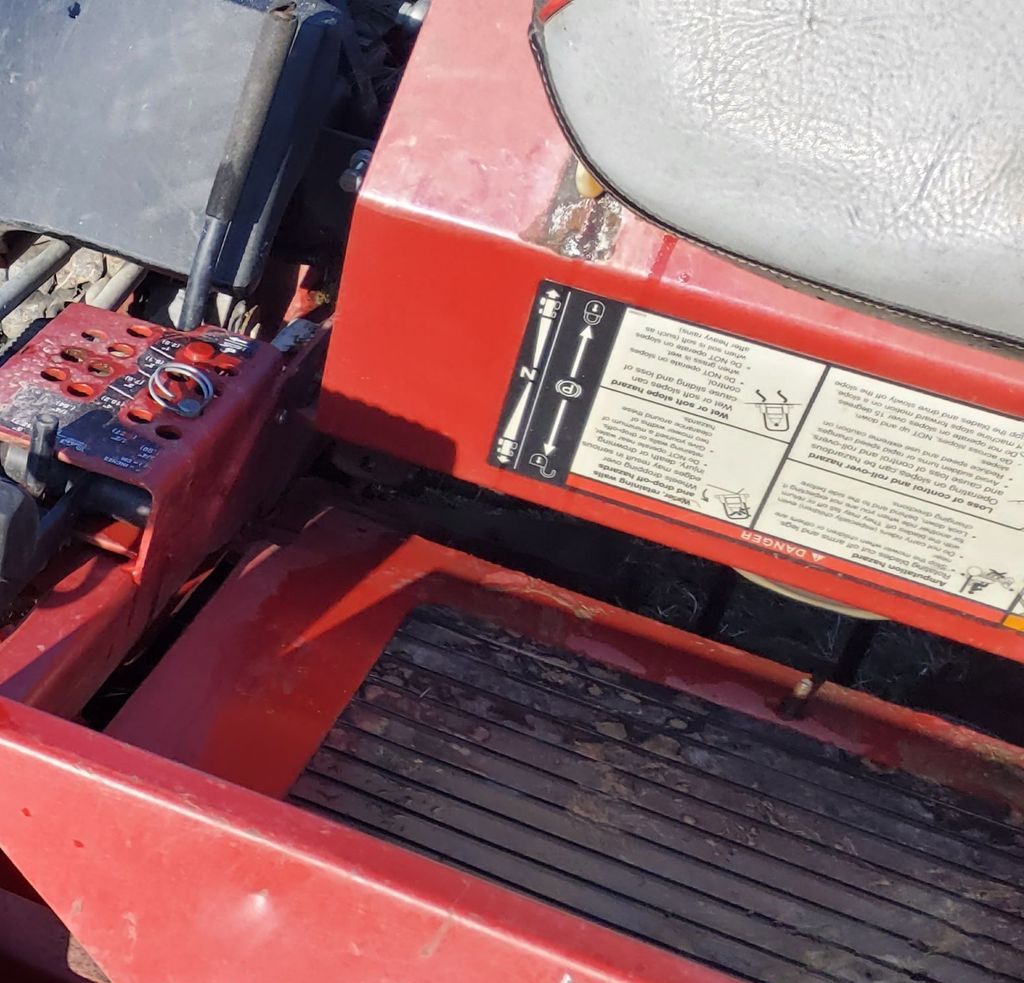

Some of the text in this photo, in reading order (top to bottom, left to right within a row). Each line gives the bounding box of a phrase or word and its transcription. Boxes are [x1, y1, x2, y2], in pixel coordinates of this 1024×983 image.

[622, 363, 738, 401] cause sliding and loss of
[649, 380, 681, 395] slopes
[610, 378, 729, 419] Wet or soft slope hazard
[681, 391, 700, 400] soft
[701, 396, 712, 404] or
[713, 400, 733, 411] Wet
[581, 440, 614, 455] serious
[810, 442, 861, 463] hazardous
[858, 448, 878, 458] and
[624, 454, 651, 466] result
[649, 453, 676, 465] death
[862, 459, 877, 468] be
[878, 454, 914, 469] control
[602, 456, 697, 490] Wheels dropping over
[651, 461, 672, 472] may
[678, 460, 705, 475] injury,
[914, 465, 927, 473] of
[592, 469, 617, 481] walls
[597, 462, 695, 497] and drop-off hazards
[672, 468, 702, 482] edges
[898, 469, 932, 484] slopes
[927, 469, 949, 480] loss
[617, 476, 661, 495] retaining
[807, 451, 994, 513] Loss of control and roll-over hazard
[932, 480, 947, 488] on
[950, 475, 982, 489] cause
[947, 483, 999, 505] Operating
[982, 485, 1004, 496] and
[740, 529, 807, 557] DANGER
[851, 552, 947, 587] Amputation hazard
